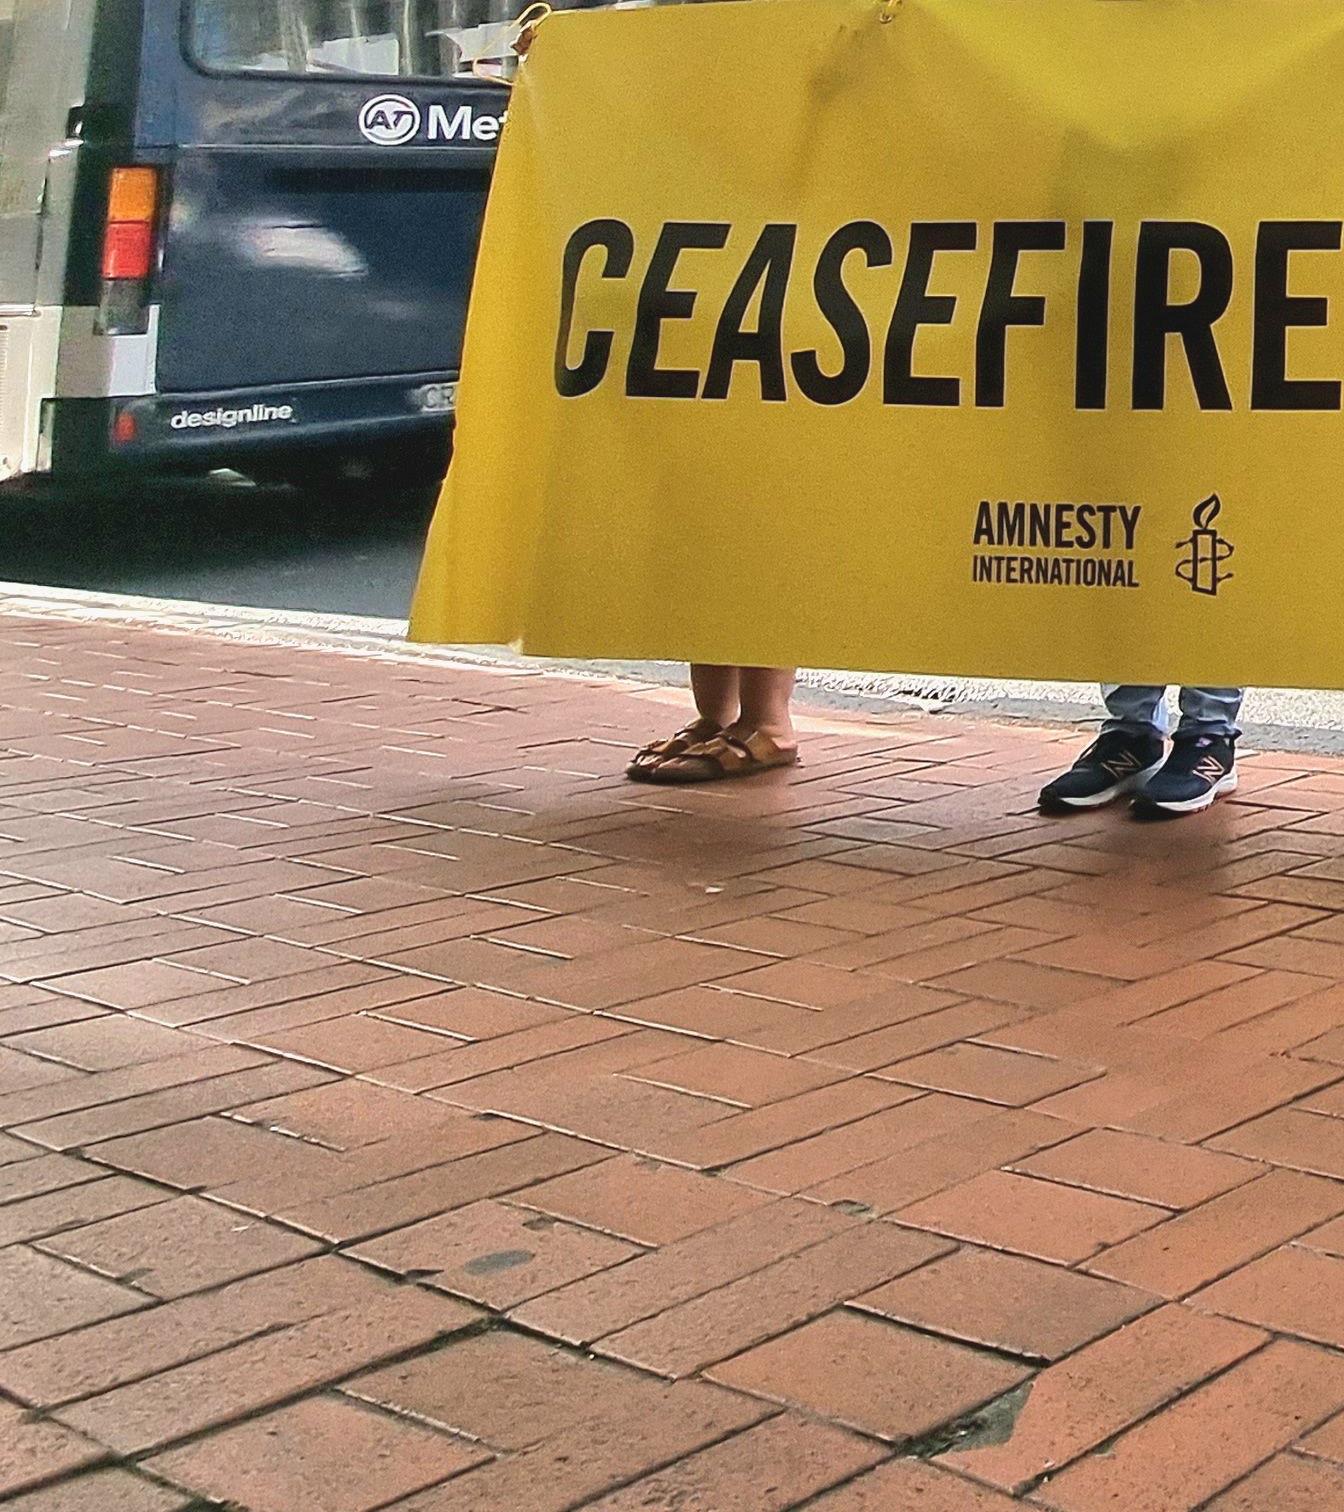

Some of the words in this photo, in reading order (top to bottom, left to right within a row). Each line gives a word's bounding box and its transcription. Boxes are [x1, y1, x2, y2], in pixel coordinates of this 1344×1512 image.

[553, 217, 1343, 412] CEASEFIRE
[170, 403, 293, 429] designline
[972, 500, 1142, 550] AMNESTY
[972, 555, 1140, 589] INTERNATIONAL
